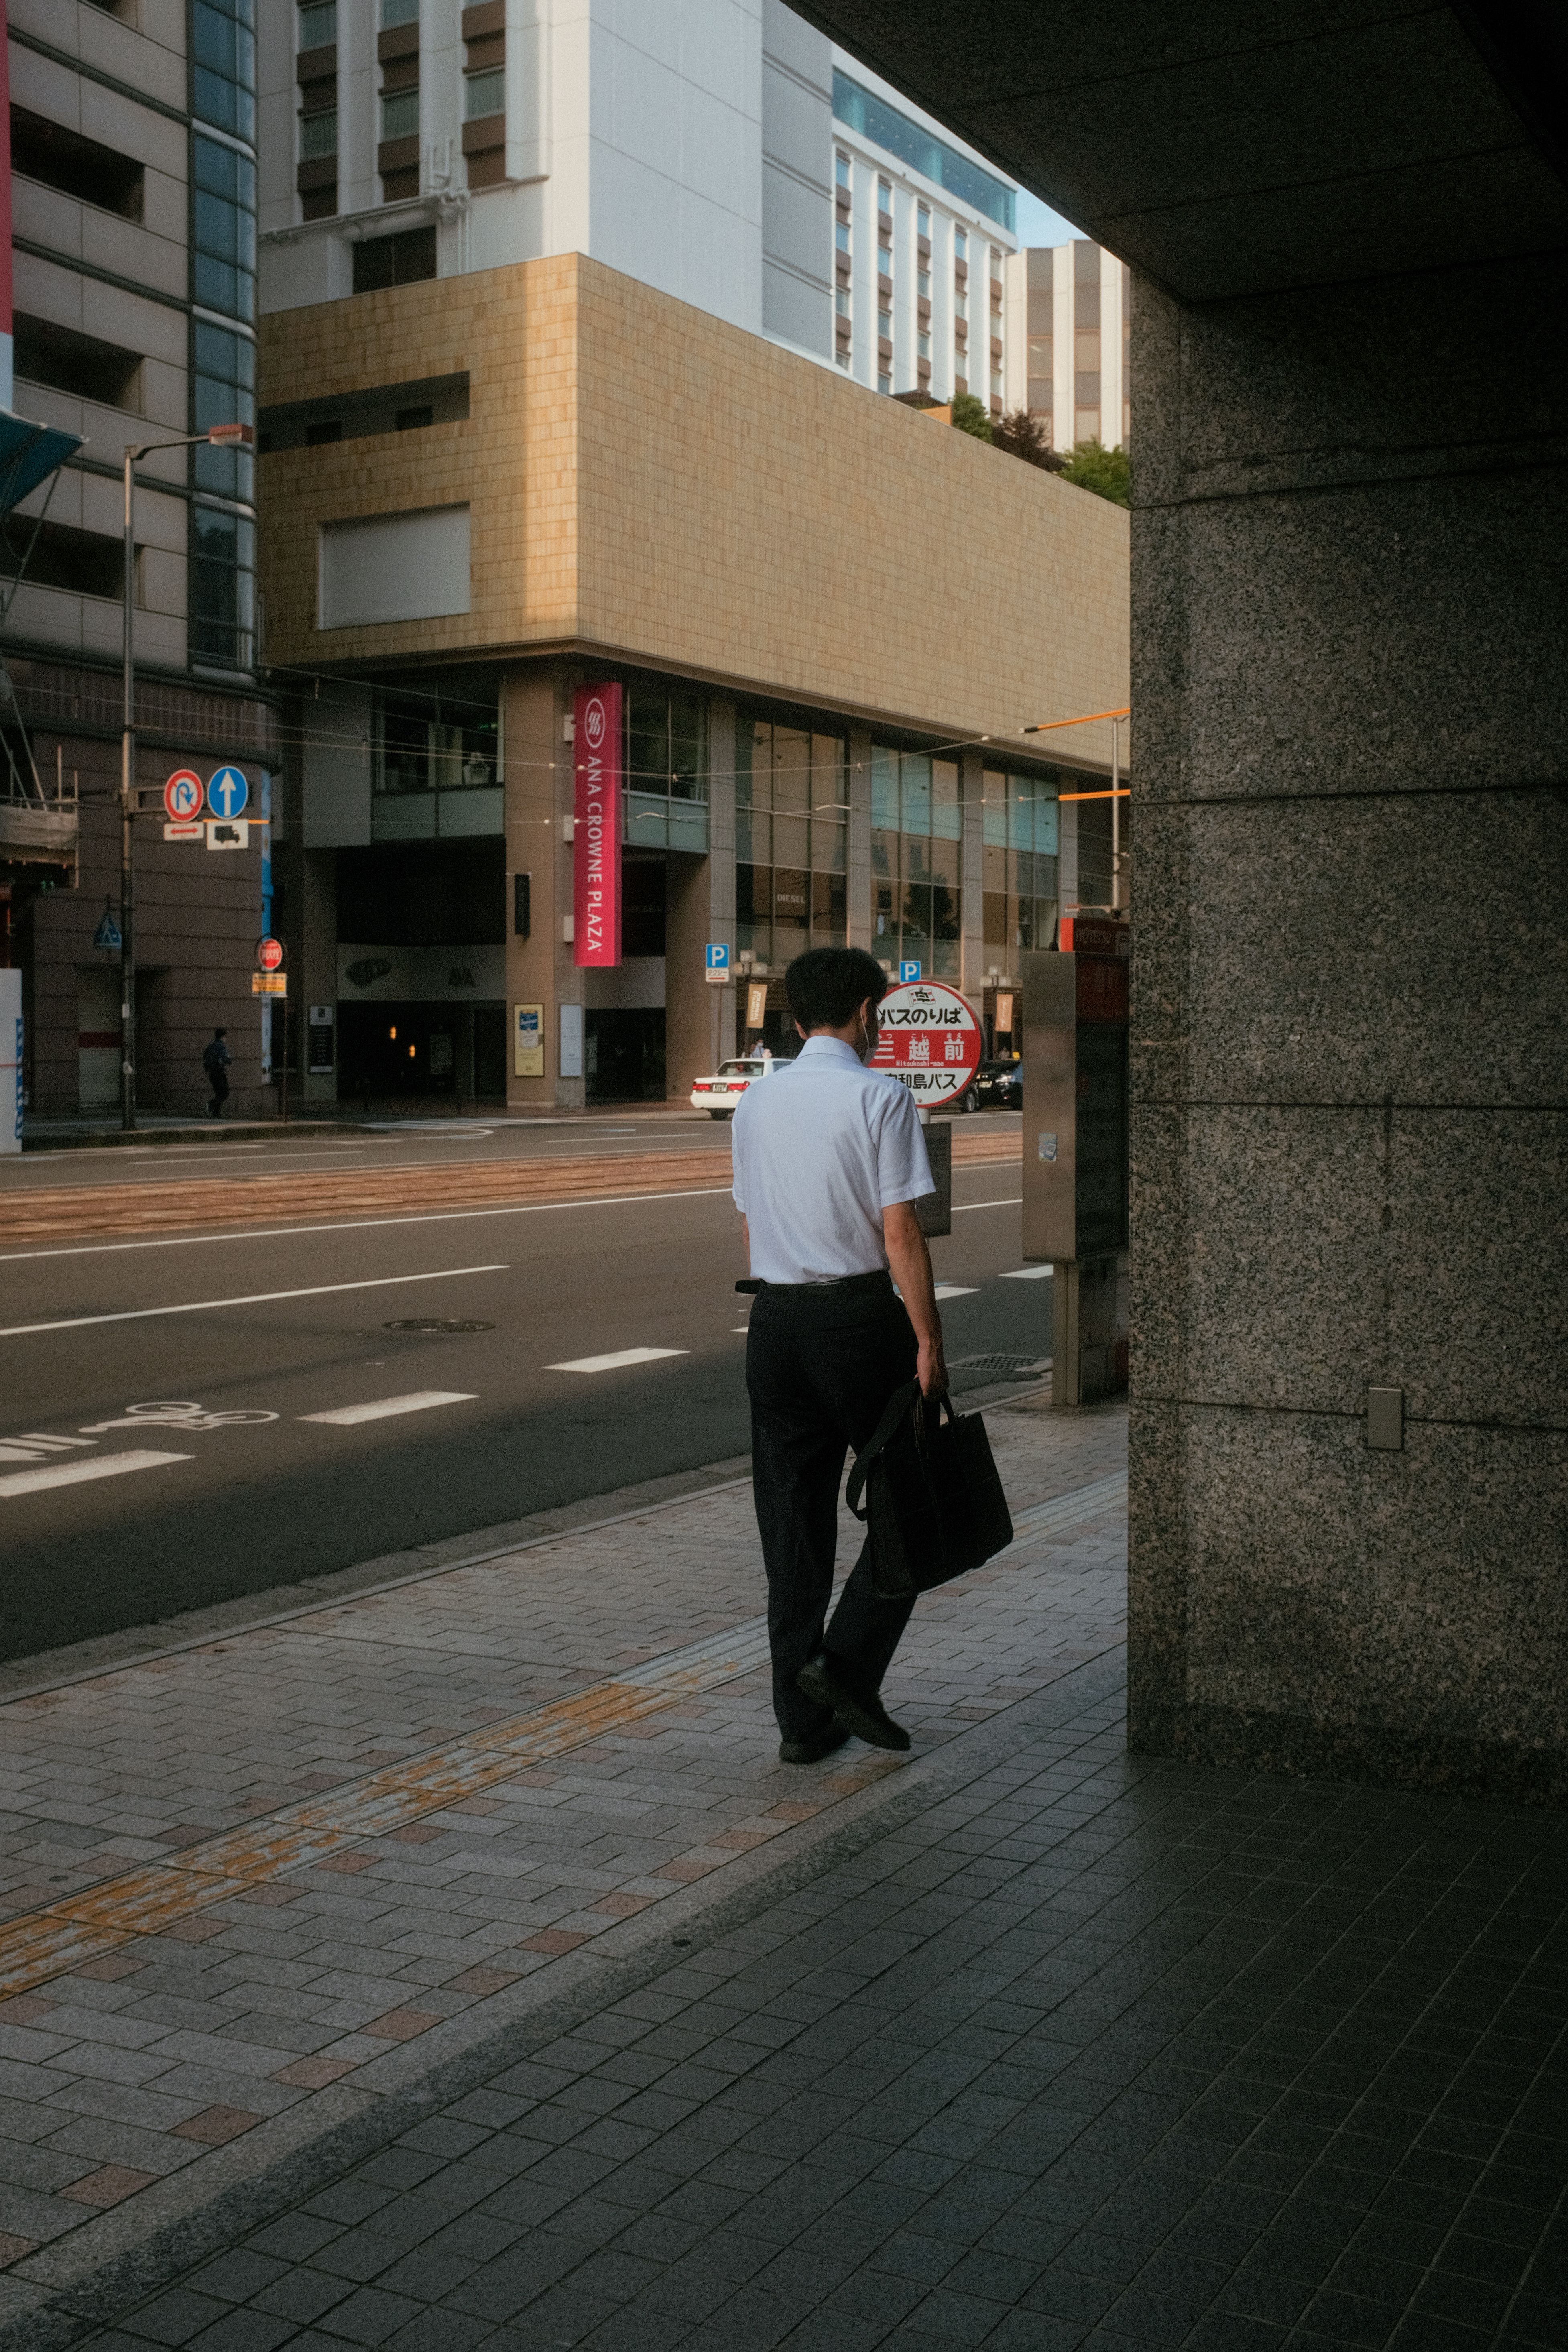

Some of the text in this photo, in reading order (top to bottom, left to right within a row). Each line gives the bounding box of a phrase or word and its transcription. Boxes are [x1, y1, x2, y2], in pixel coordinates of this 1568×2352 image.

[587, 755, 601, 796] ANA
[587, 802, 602, 883] CROWNE
[777, 894, 805, 904] DIESEL
[712, 946, 725, 966] P
[905, 963, 917, 981] P
[882, 1007, 963, 1025] バスのりば
[874, 1039, 965, 1061] 三越前
